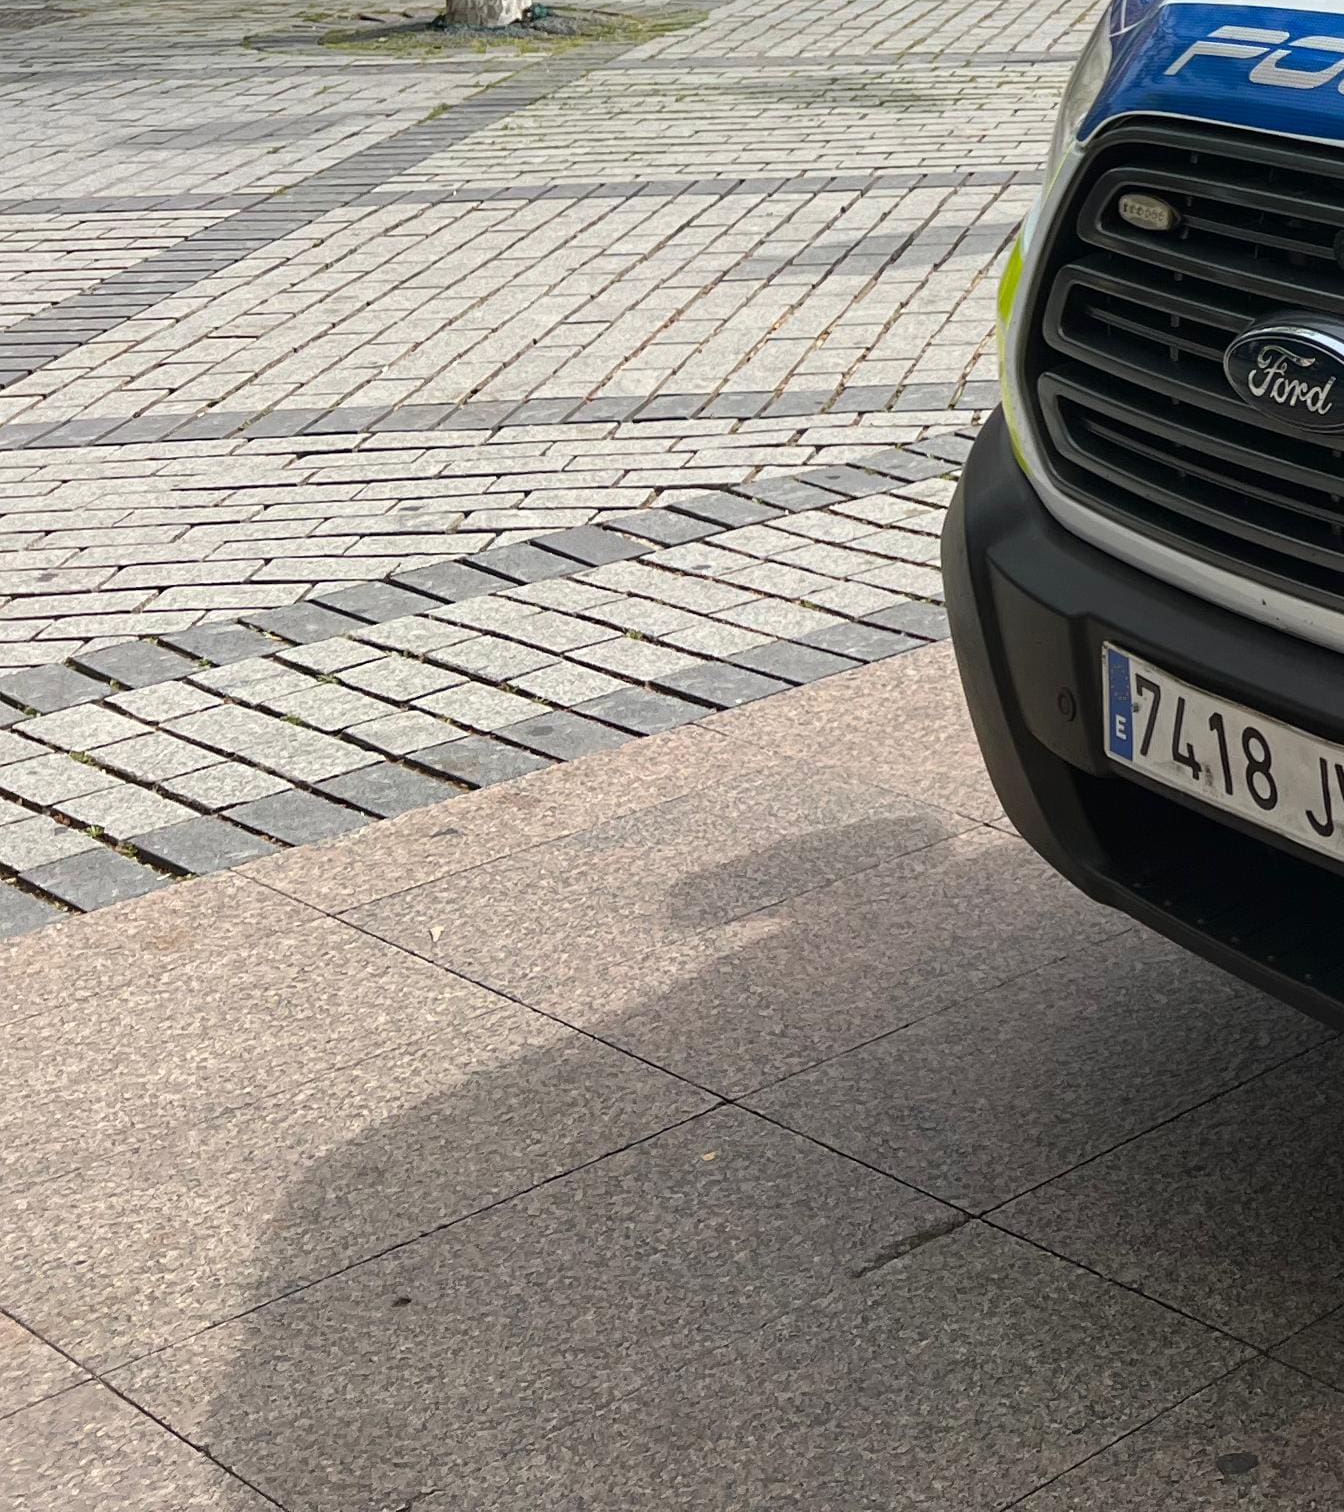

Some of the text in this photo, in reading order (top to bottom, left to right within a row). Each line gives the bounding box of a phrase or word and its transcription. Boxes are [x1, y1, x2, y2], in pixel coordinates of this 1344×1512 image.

[1248, 344, 1337, 416] Ford
[1115, 713, 1129, 740] E
[1134, 672, 1278, 812] 7418
